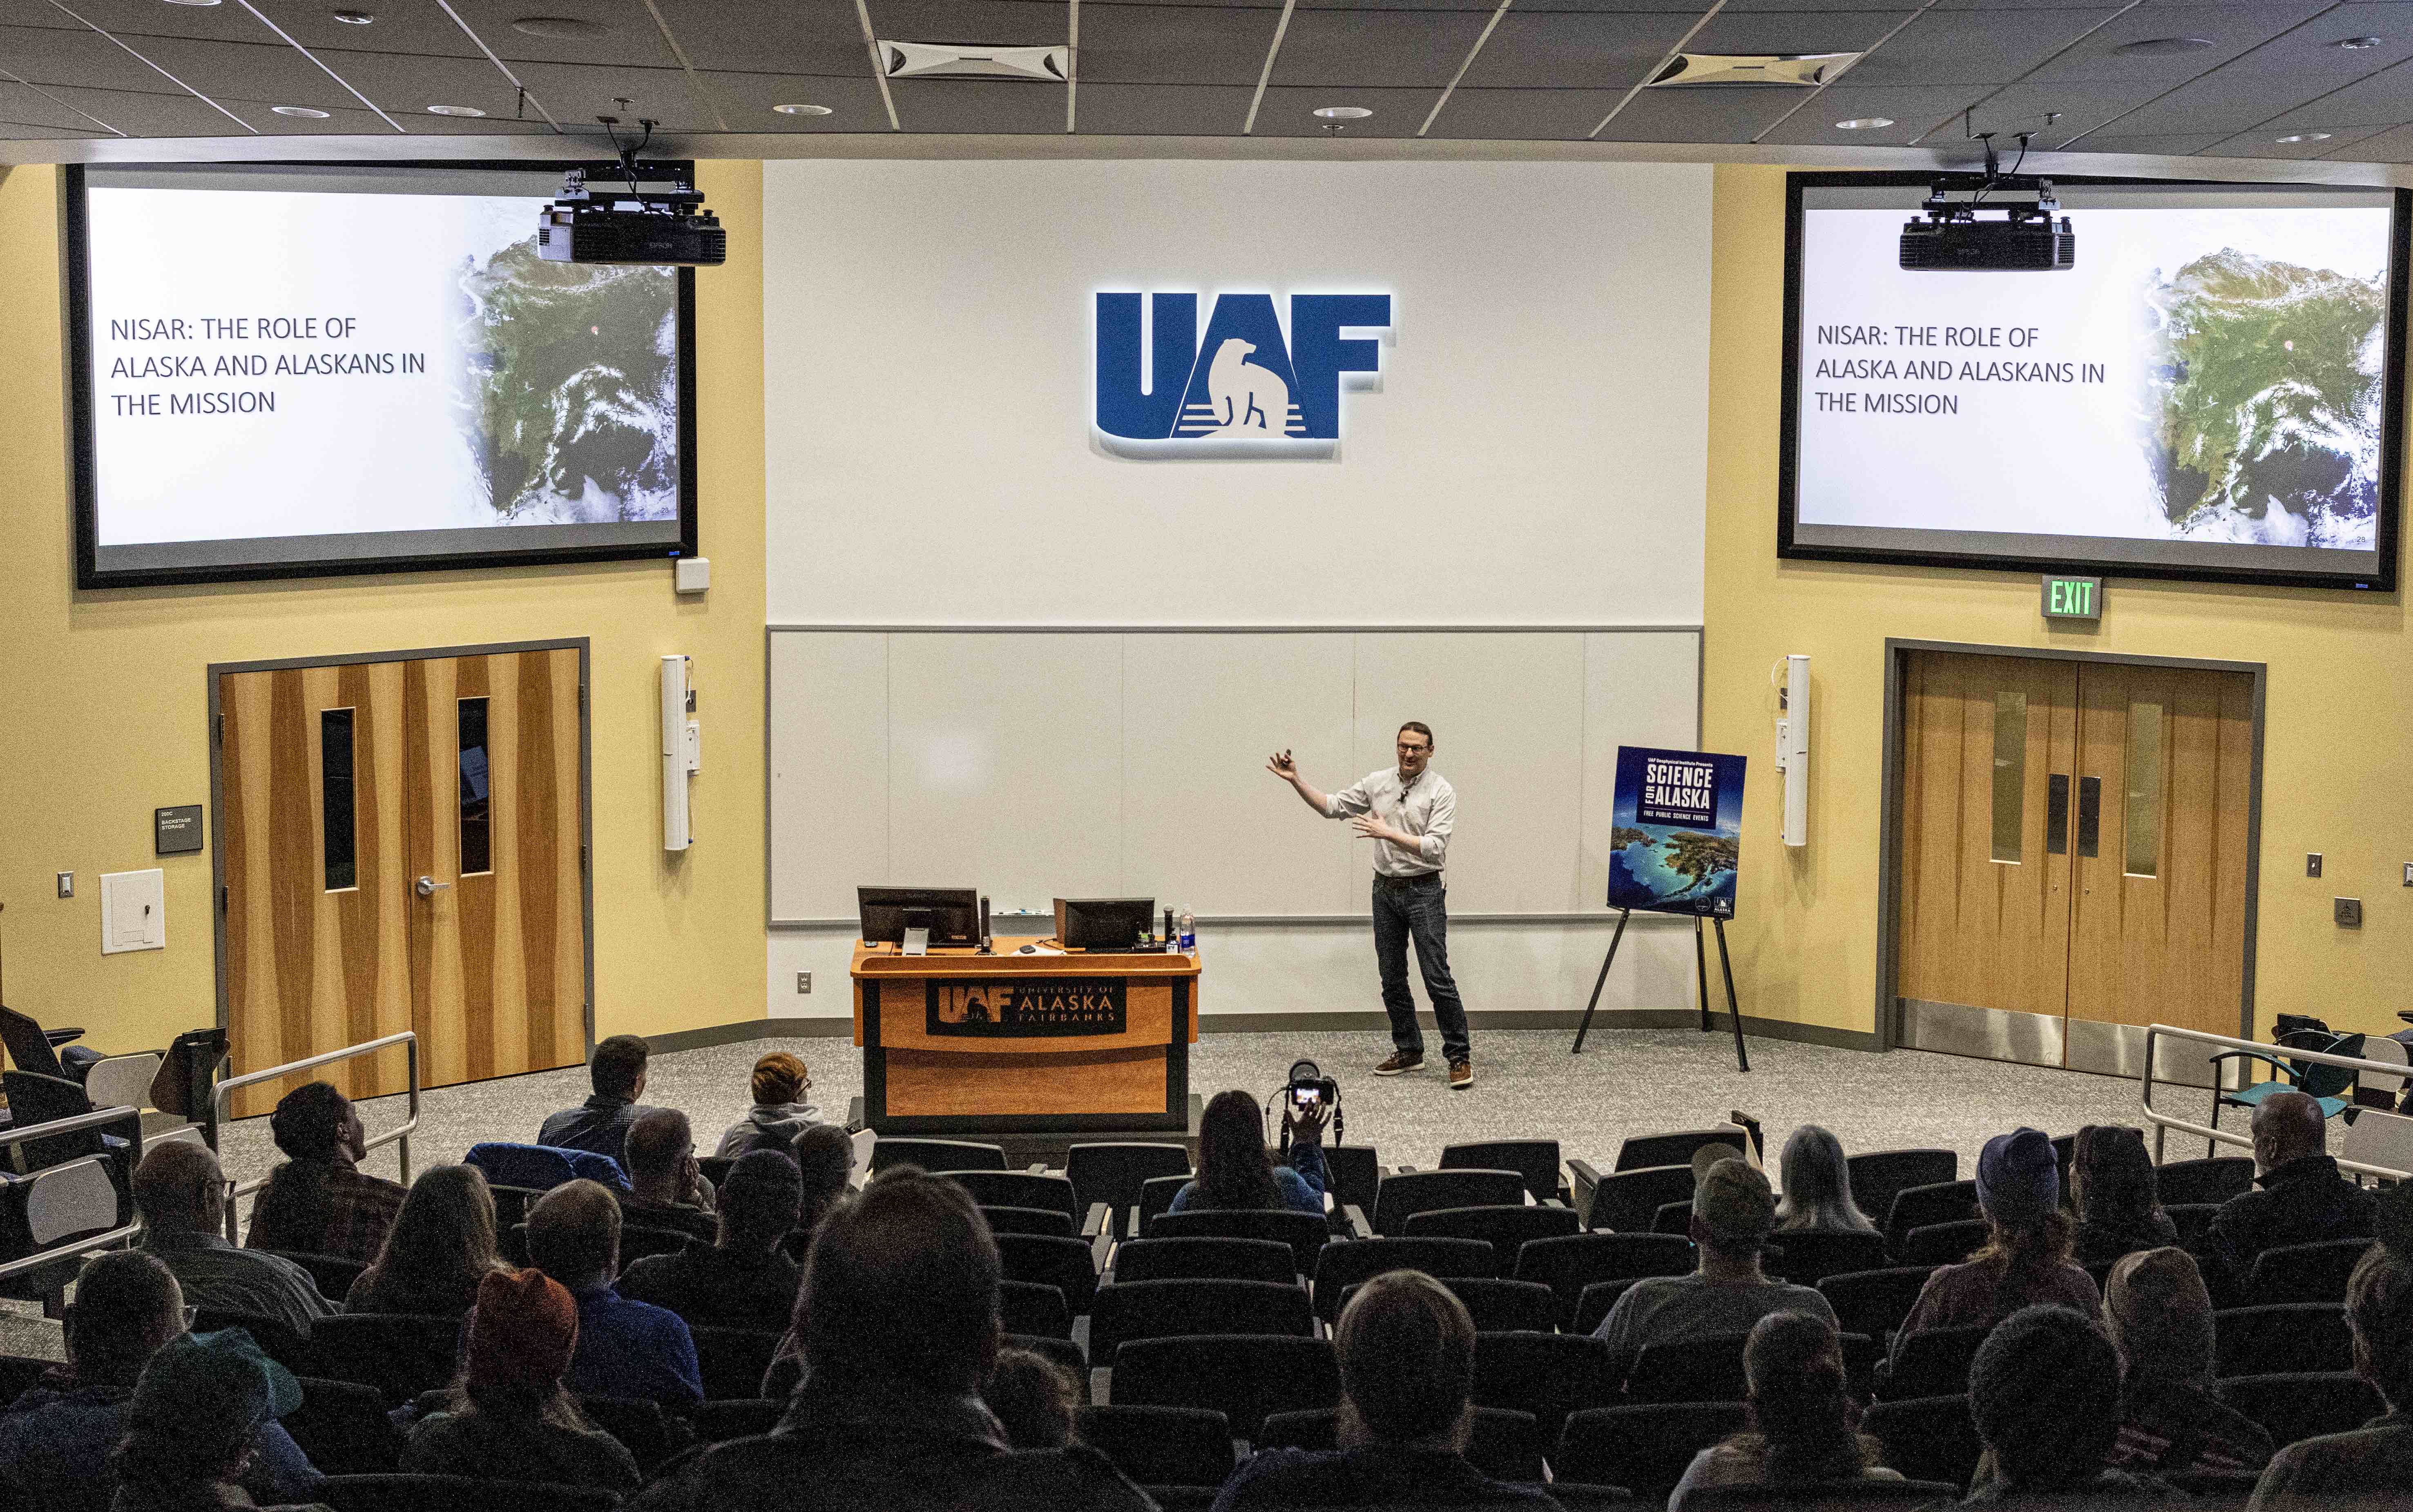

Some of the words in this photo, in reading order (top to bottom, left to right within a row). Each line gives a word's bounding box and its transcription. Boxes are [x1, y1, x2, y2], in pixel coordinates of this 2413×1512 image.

[112, 319, 193, 340] NISAR:
[201, 318, 248, 339] THE
[258, 318, 317, 338] ROLE
[325, 318, 356, 338] OF
[1818, 325, 1887, 345] NISAR:
[1895, 326, 1938, 346] THE
[1945, 327, 2001, 346] ROLE
[2009, 328, 2038, 347] OF
[111, 356, 207, 378] ALASKA
[214, 355, 267, 376] AND
[275, 353, 394, 375] ALASKANS
[402, 353, 424, 373] IN
[1096, 292, 1391, 439] UAF
[1816, 359, 1898, 379] ALASKA
[1904, 360, 1952, 380] AND
[1959, 361, 2074, 383] ALASKANS
[2082, 364, 2104, 383] IN
[111, 394, 161, 415] THE
[171, 391, 275, 414] MISSION
[1815, 392, 1857, 412] THE
[1864, 393, 1958, 414] MISSION
[2051, 581, 2093, 614] EXIT
[1647, 764, 1713, 788] SCIENCE
[1645, 785, 1655, 804] FOR
[1655, 786, 1710, 809] ALASKA
[939, 986, 1014, 1024] UAF
[1020, 995, 1113, 1011] ALASKA
[1019, 1013, 1115, 1022] FAIRBANKS
